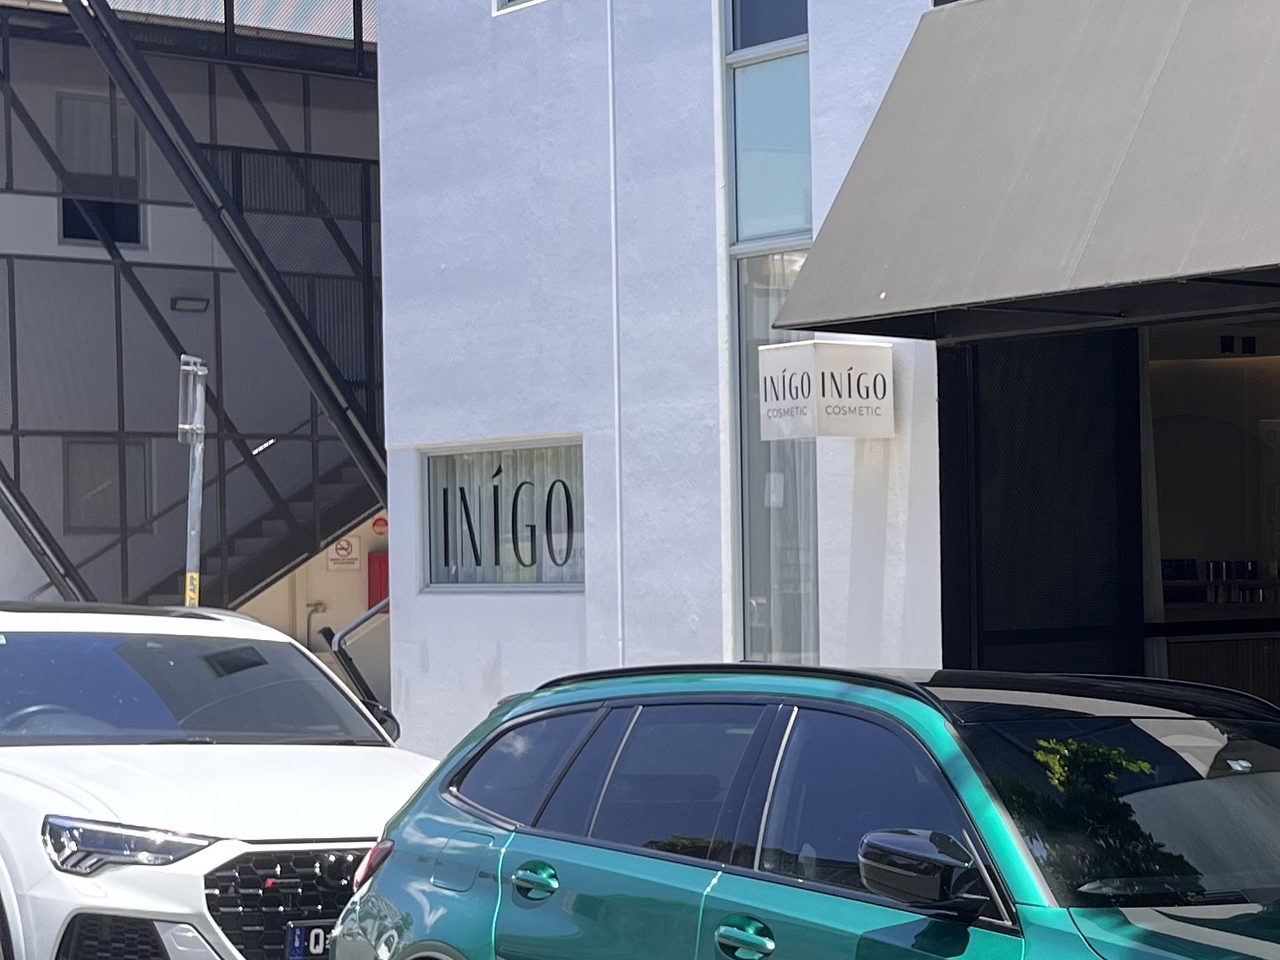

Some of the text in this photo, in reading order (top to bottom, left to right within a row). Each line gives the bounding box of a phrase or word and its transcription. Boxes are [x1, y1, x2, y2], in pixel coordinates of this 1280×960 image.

[763, 368, 811, 402] INÍGO
[821, 366, 887, 401] INÍGO
[766, 406, 808, 419] COSMETIC
[825, 404, 882, 417] COSMETIC
[443, 464, 575, 568] INÍGO
